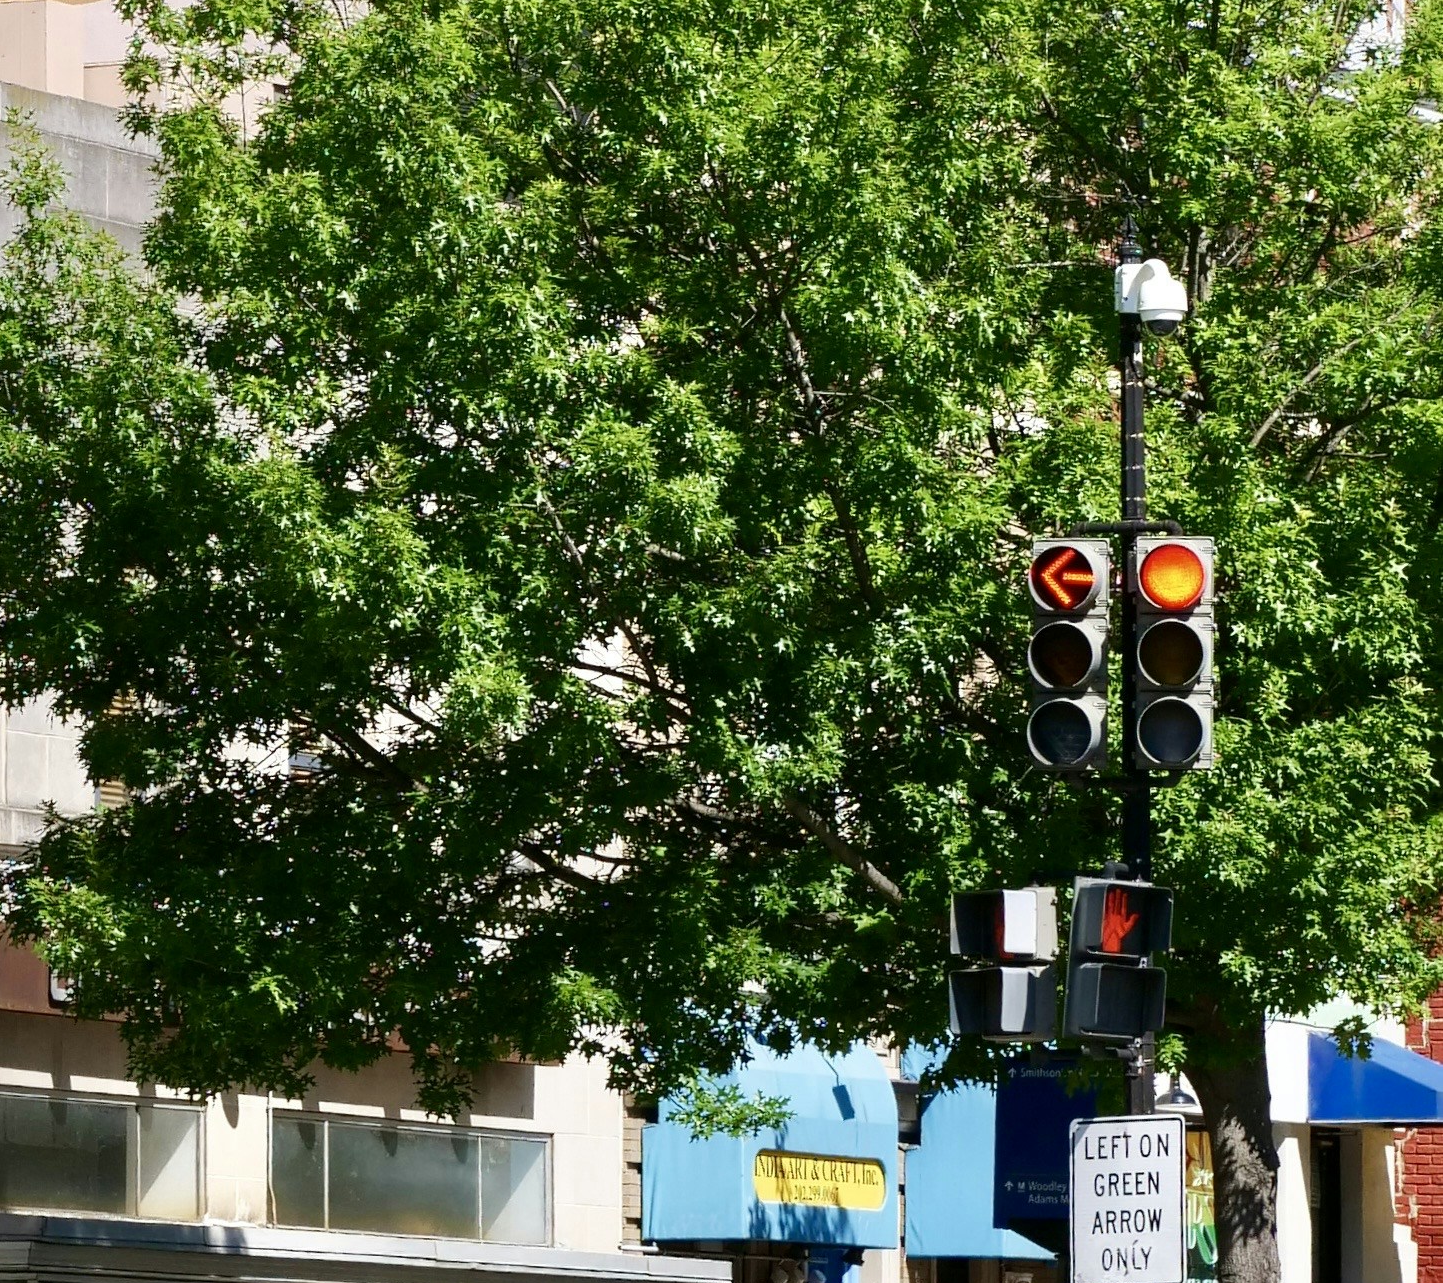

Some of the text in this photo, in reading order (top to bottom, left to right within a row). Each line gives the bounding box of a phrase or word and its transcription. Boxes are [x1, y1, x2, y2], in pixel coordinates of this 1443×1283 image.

[1085, 1133, 1169, 1160] LEFT ON
[787, 1157, 808, 1180] ART
[811, 1159, 819, 1181] &
[862, 1163, 879, 1186] Inc.
[1094, 1171, 1160, 1197] GREEN
[1028, 1180, 1067, 1193] Woodley
[1028, 1193, 1058, 1204] Adams
[1092, 1208, 1162, 1235] ARROW
[1101, 1246, 1152, 1272] ONLY
